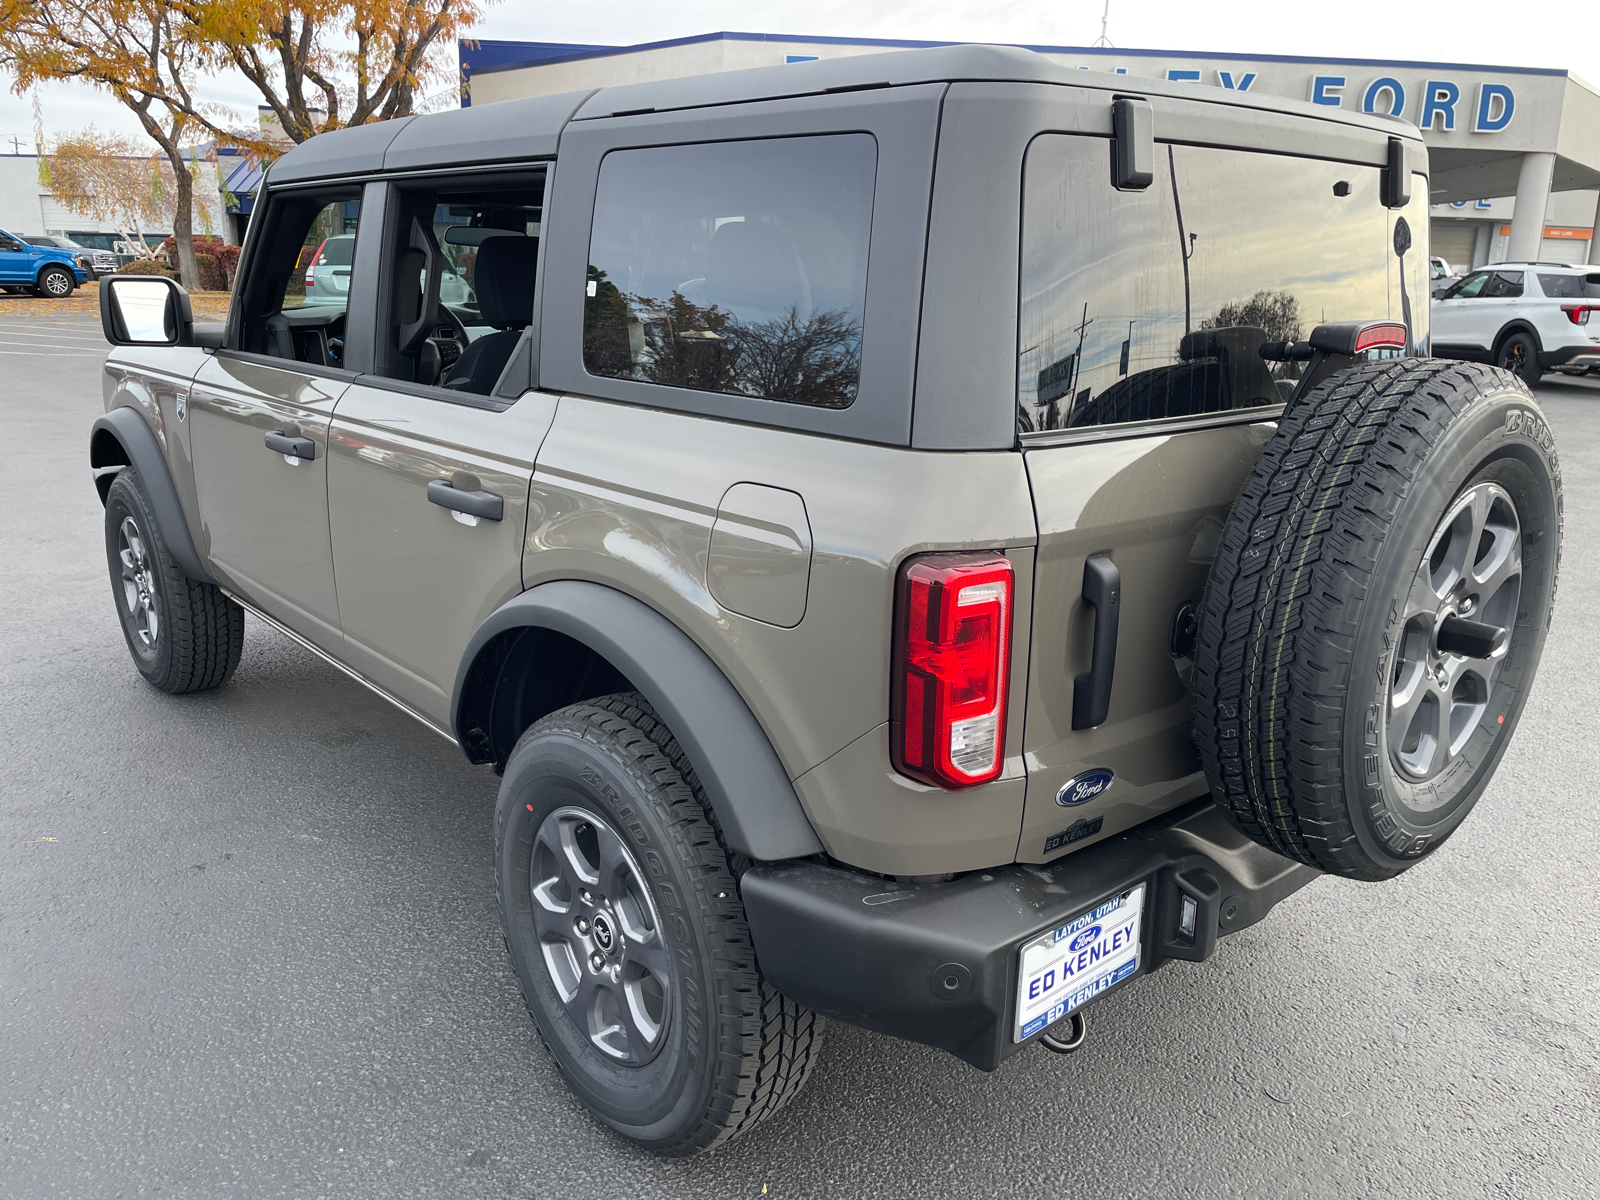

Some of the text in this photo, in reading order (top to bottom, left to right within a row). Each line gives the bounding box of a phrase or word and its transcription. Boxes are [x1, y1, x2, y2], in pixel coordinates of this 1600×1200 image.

[1311, 75, 1516, 133] FORD
[1363, 702, 1433, 856] DUELER
[1045, 838, 1060, 850] ED
[1062, 821, 1101, 844] KENLEY
[578, 764, 701, 1072] BRIDGESTONE
[1055, 897, 1120, 941] LAYTON, UTAH
[1028, 921, 1135, 1000] ED KENLEY
[1046, 1003, 1065, 1025] ED
